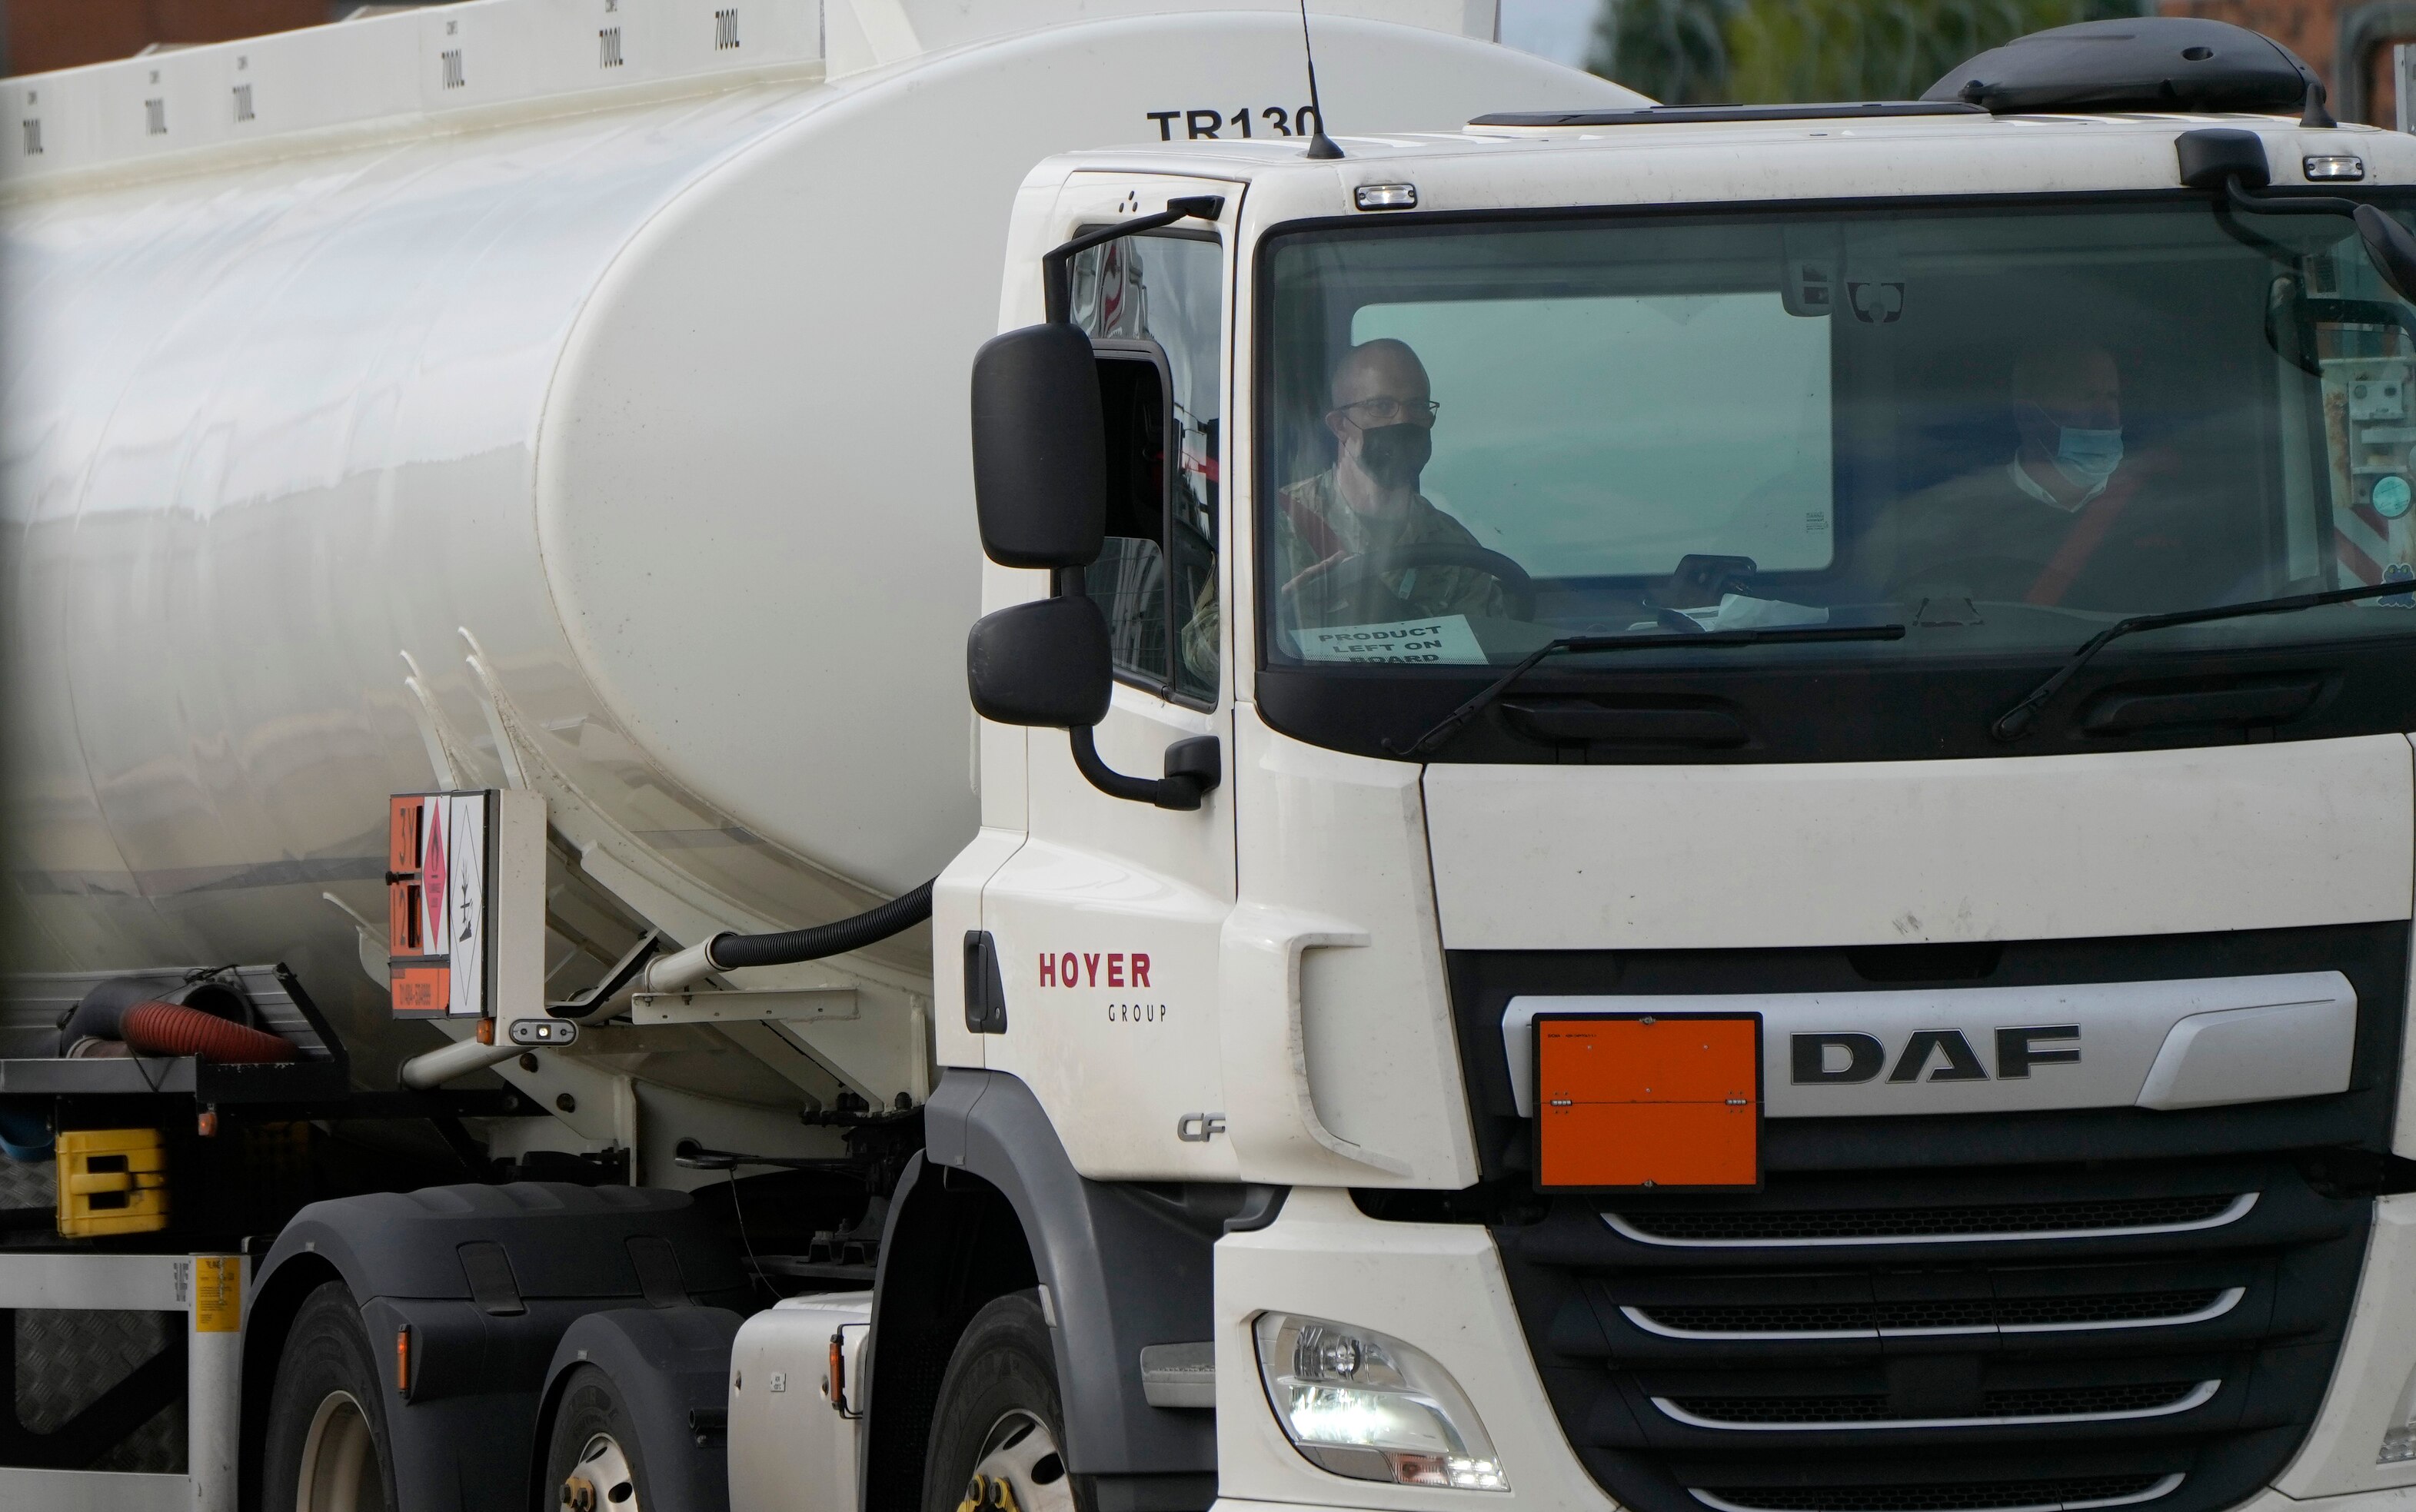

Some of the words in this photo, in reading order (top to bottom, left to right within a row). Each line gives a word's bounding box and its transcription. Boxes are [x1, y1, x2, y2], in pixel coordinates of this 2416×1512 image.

[715, 8, 740, 51] 7000L
[598, 26, 624, 69] 7000L
[1318, 626, 1442, 643] PRODUCT
[1333, 643, 1396, 653] LEFT
[1404, 640, 1443, 650] ON
[1040, 952, 1151, 988] HOYER
[1108, 1004, 1166, 1022] GROUP
[1789, 1022, 2082, 1086] DAF
[1177, 1112, 1226, 1142] CF
